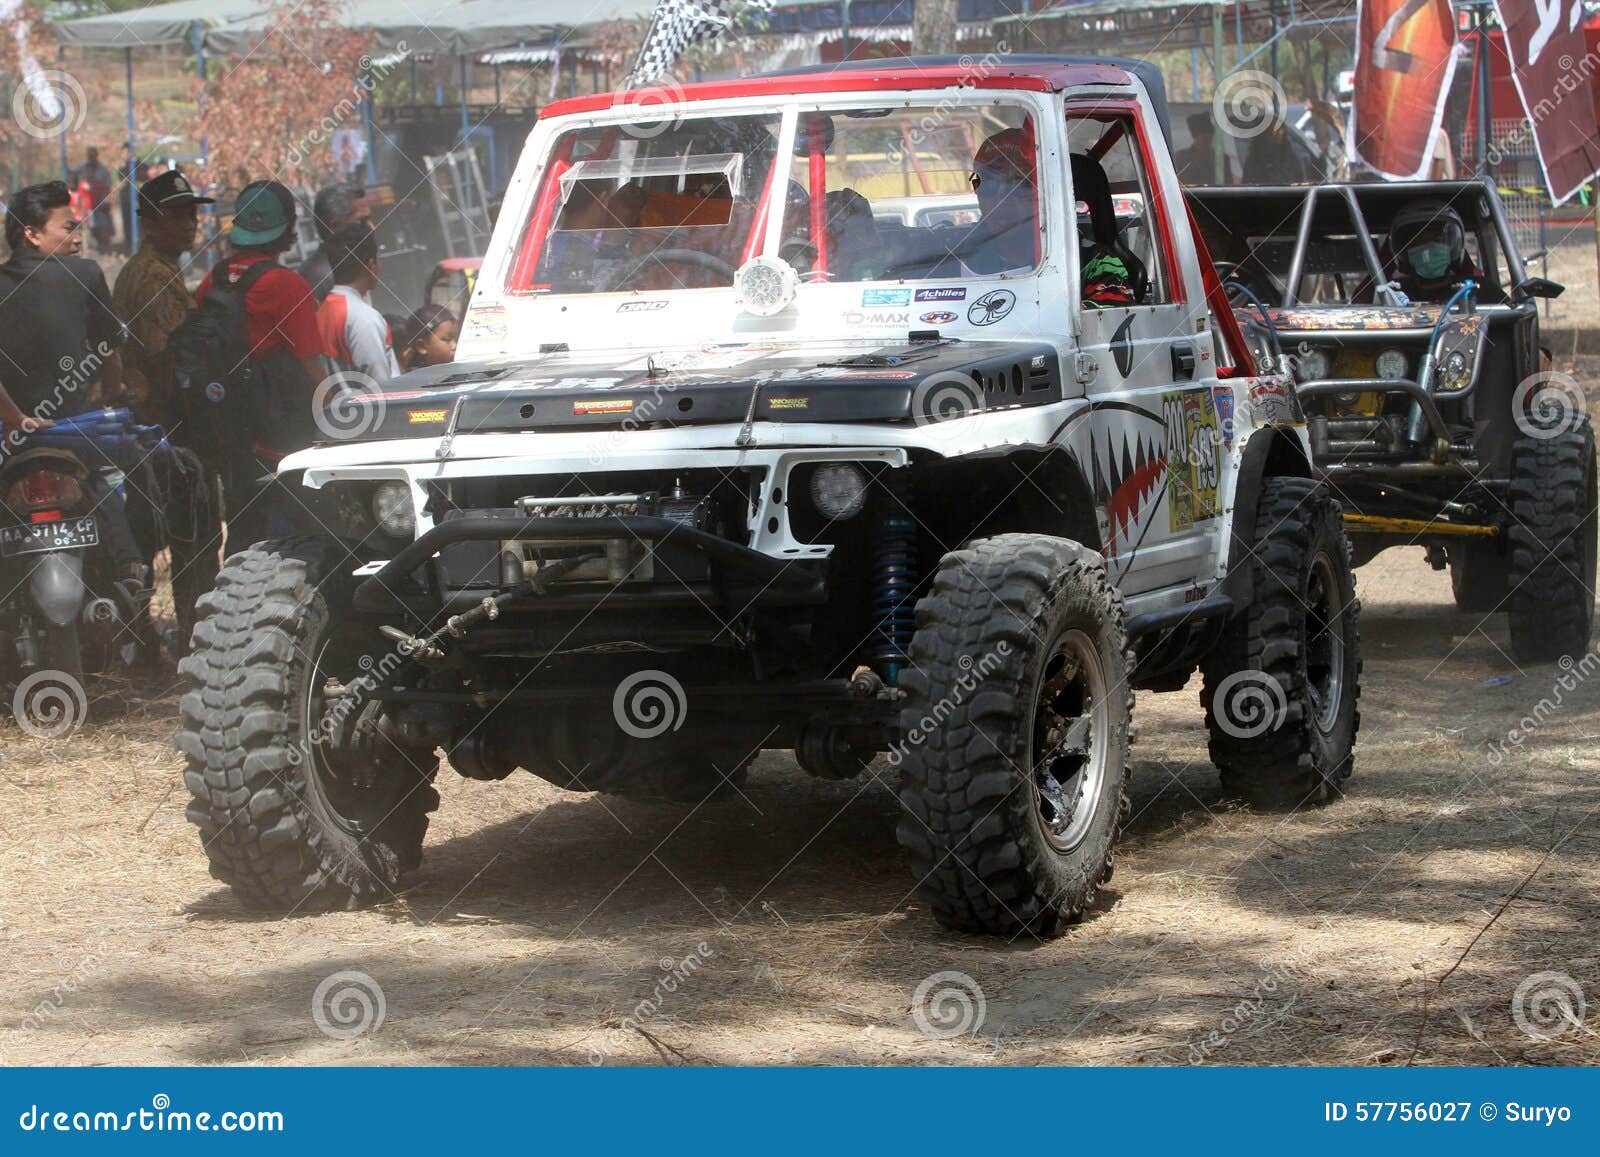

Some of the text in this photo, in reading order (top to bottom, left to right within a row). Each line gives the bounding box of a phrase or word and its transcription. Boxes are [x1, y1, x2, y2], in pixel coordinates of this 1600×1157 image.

[917, 289, 965, 297] Achilles
[32, 522, 68, 537] 5714
[76, 519, 93, 532] CP
